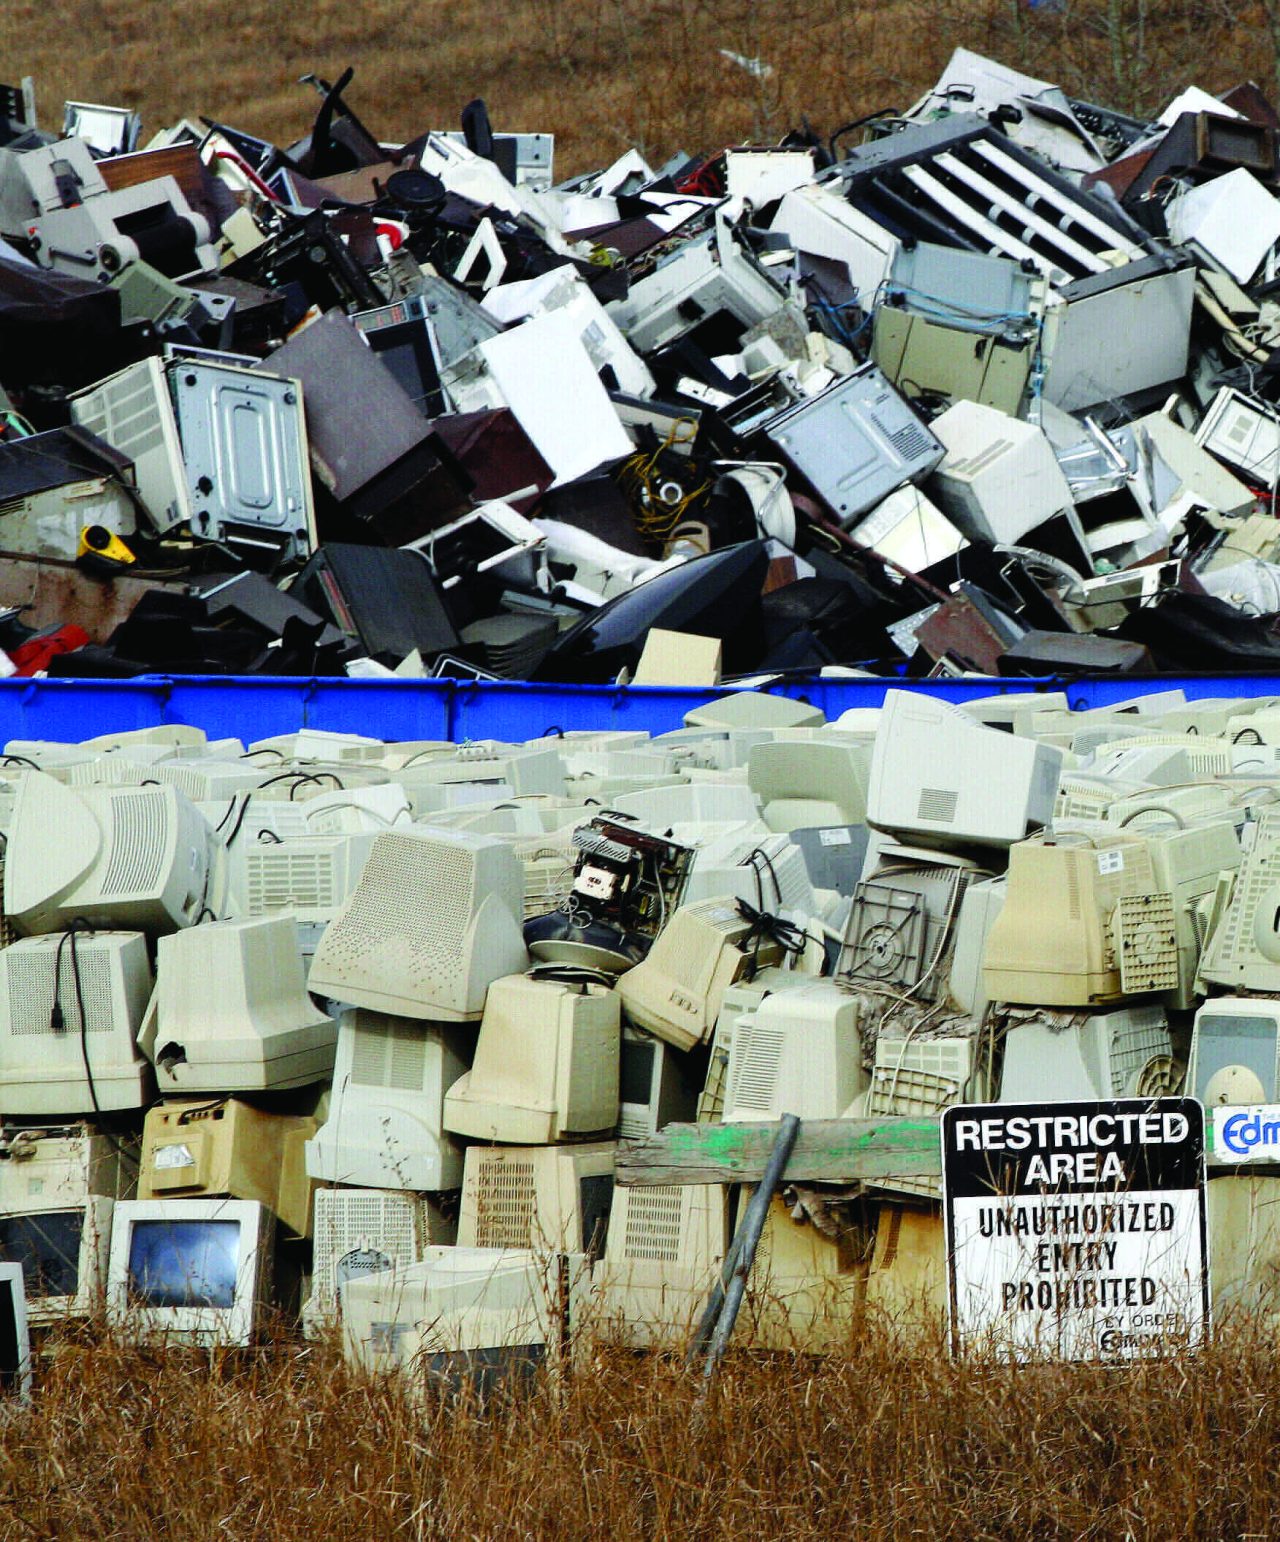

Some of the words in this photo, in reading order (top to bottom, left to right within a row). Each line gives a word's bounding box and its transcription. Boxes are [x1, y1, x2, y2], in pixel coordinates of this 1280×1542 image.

[955, 1112, 1189, 1150] RESTRICTED
[1024, 1151, 1127, 1186] AREA
[978, 1202, 1175, 1237] UNAUTHORIZED
[1038, 1241, 1117, 1272] ENTRY
[1002, 1277, 1156, 1312] PROHIBITED
